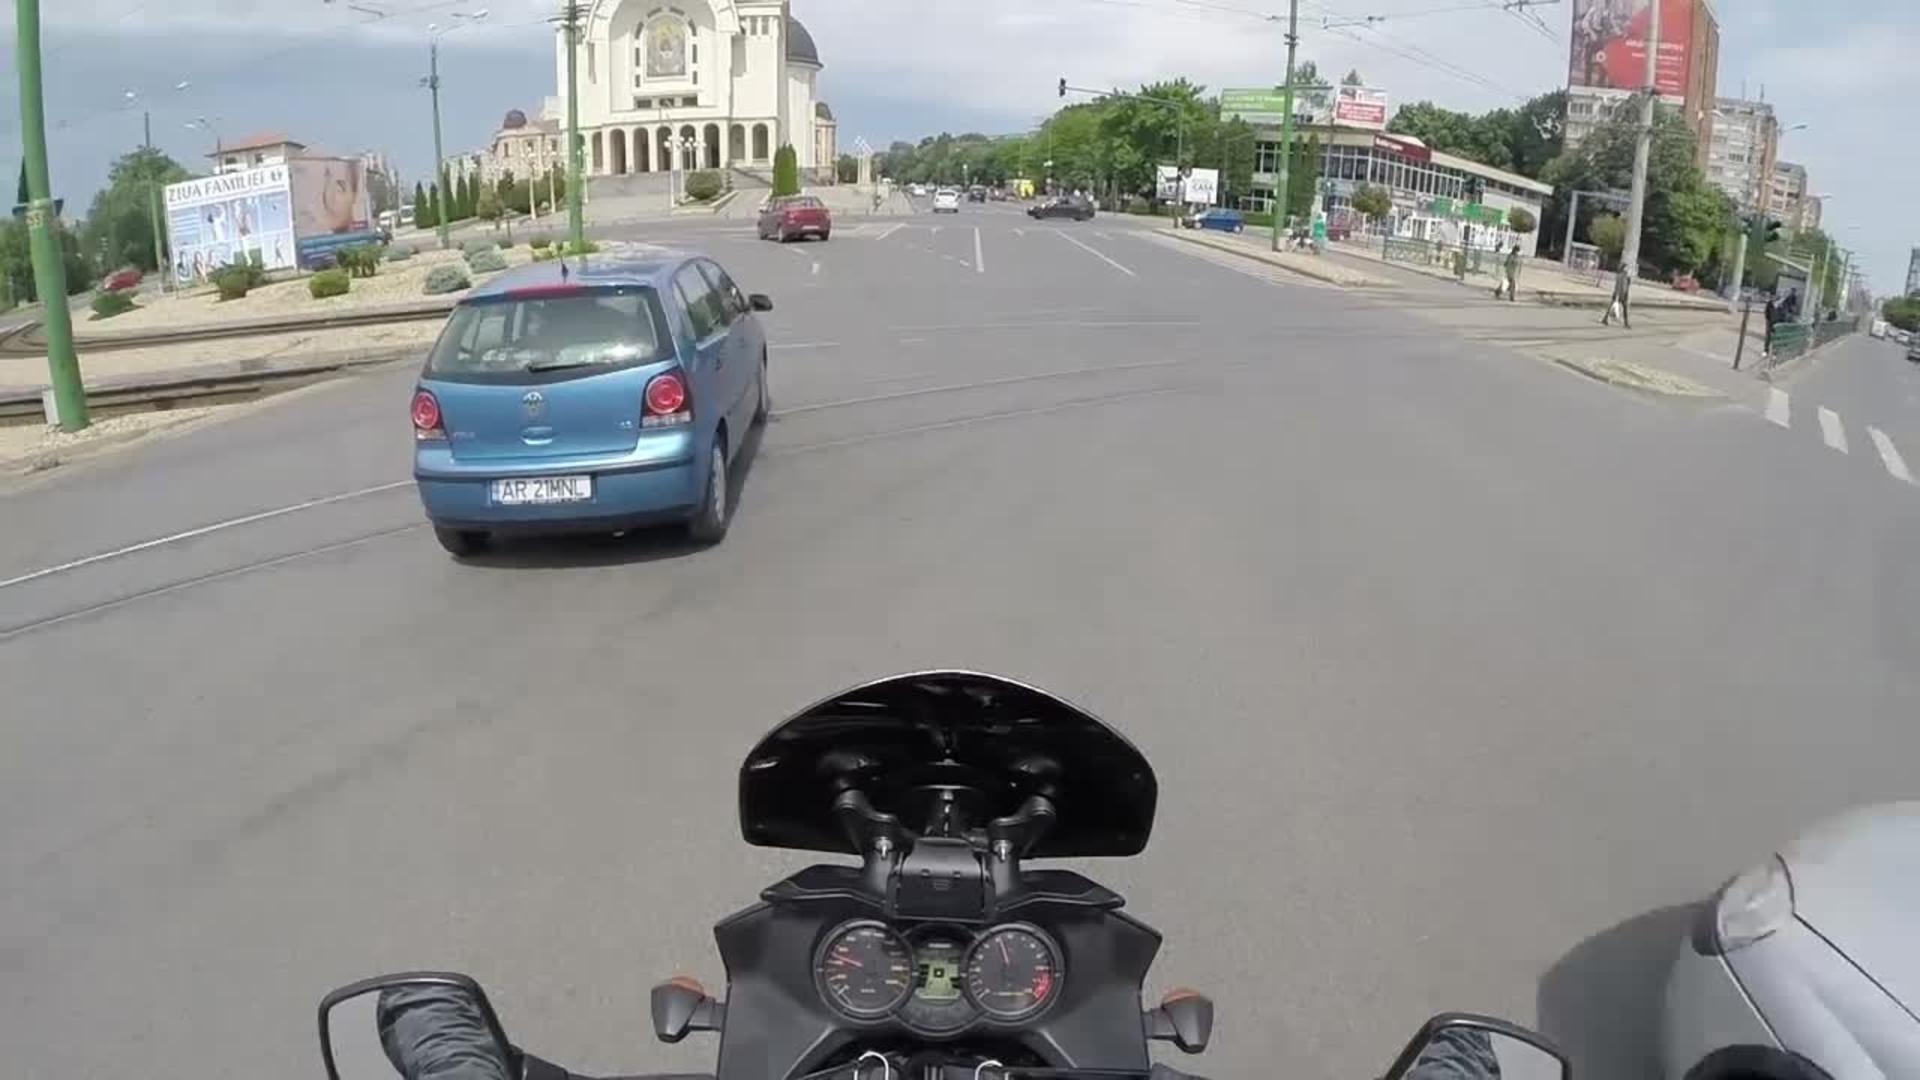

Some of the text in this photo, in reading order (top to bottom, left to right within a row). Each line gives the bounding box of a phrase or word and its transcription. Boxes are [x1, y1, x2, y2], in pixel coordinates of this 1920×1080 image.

[168, 170, 265, 202] ZIUA FAMILIEI
[503, 480, 527, 499] AR
